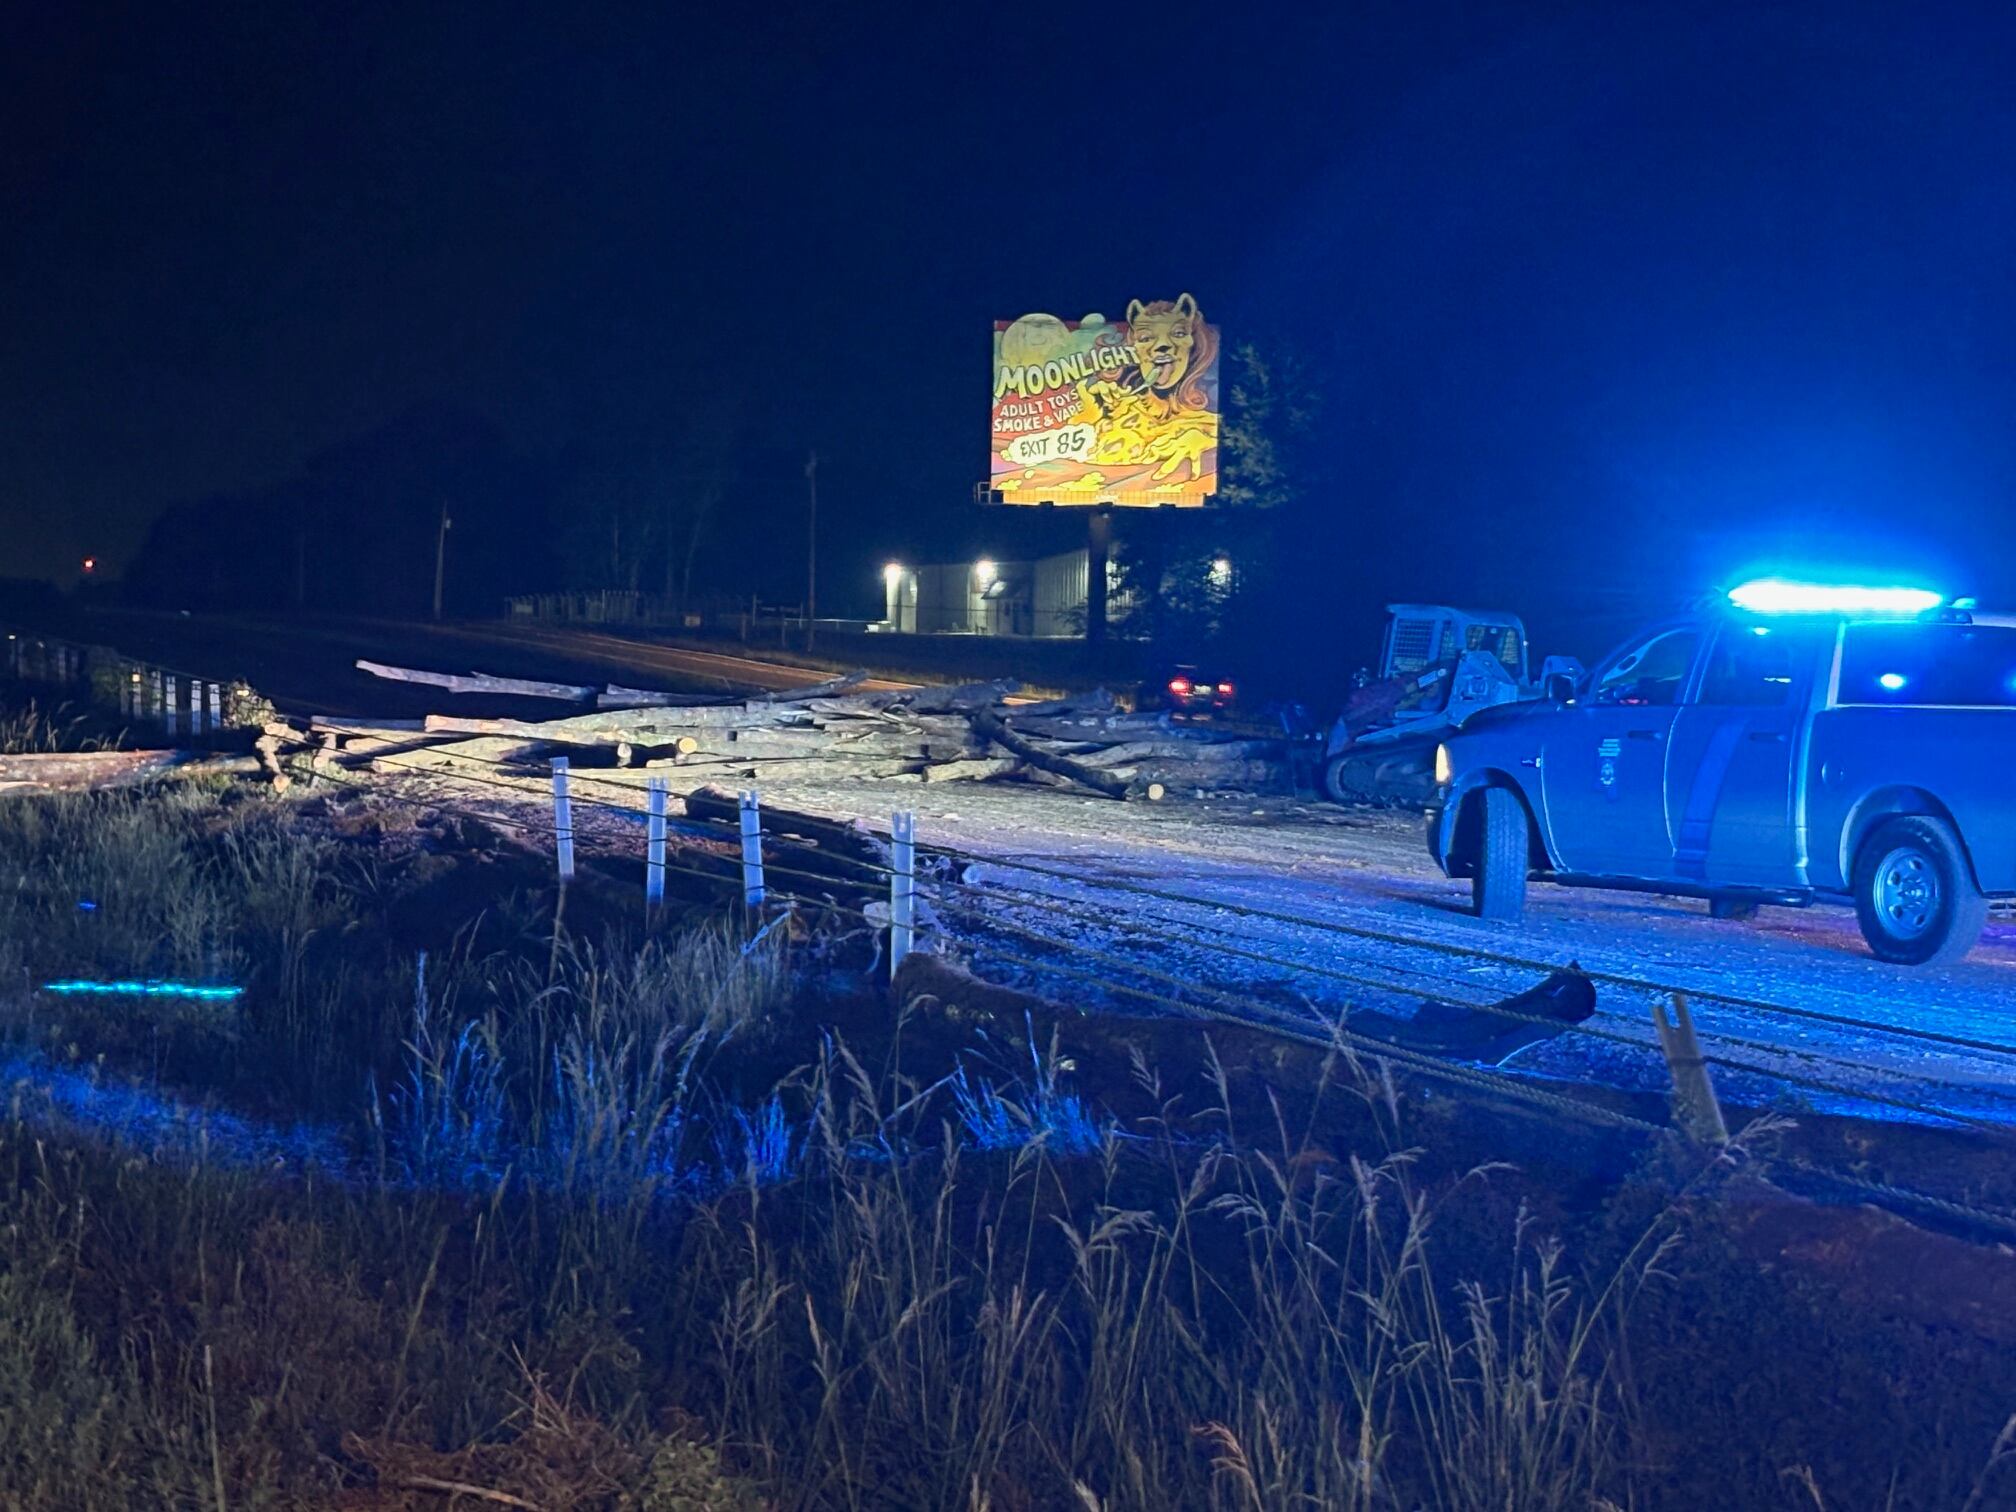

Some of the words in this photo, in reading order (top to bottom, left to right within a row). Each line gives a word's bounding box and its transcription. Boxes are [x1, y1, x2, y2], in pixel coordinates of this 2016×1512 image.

[994, 346, 1140, 399] MOONLIGHT
[993, 416, 1040, 432] SMOKE
[1043, 415, 1054, 427] &
[1053, 401, 1083, 423] VAPE
[1000, 400, 1044, 417] ADULT
[1047, 388, 1078, 408] TOYS
[1020, 437, 1050, 457] EXIT
[1057, 429, 1086, 454] 85
